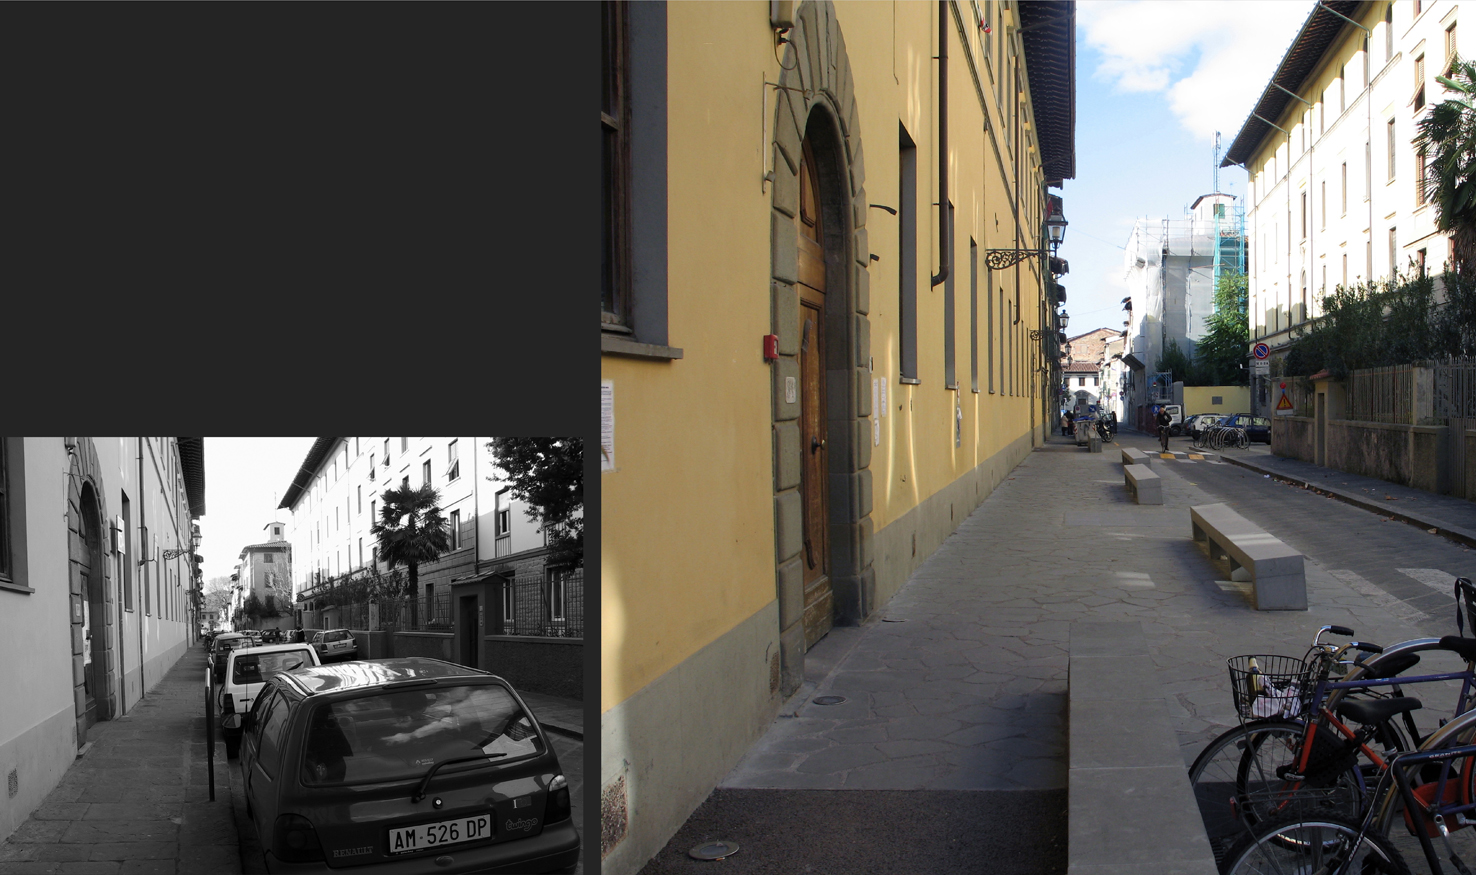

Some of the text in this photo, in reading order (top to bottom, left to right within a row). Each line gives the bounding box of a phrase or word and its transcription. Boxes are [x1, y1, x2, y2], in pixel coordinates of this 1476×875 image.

[505, 817, 539, 832] twingo
[394, 818, 488, 850] AM 526 DP
[333, 846, 374, 858] RENAULT
